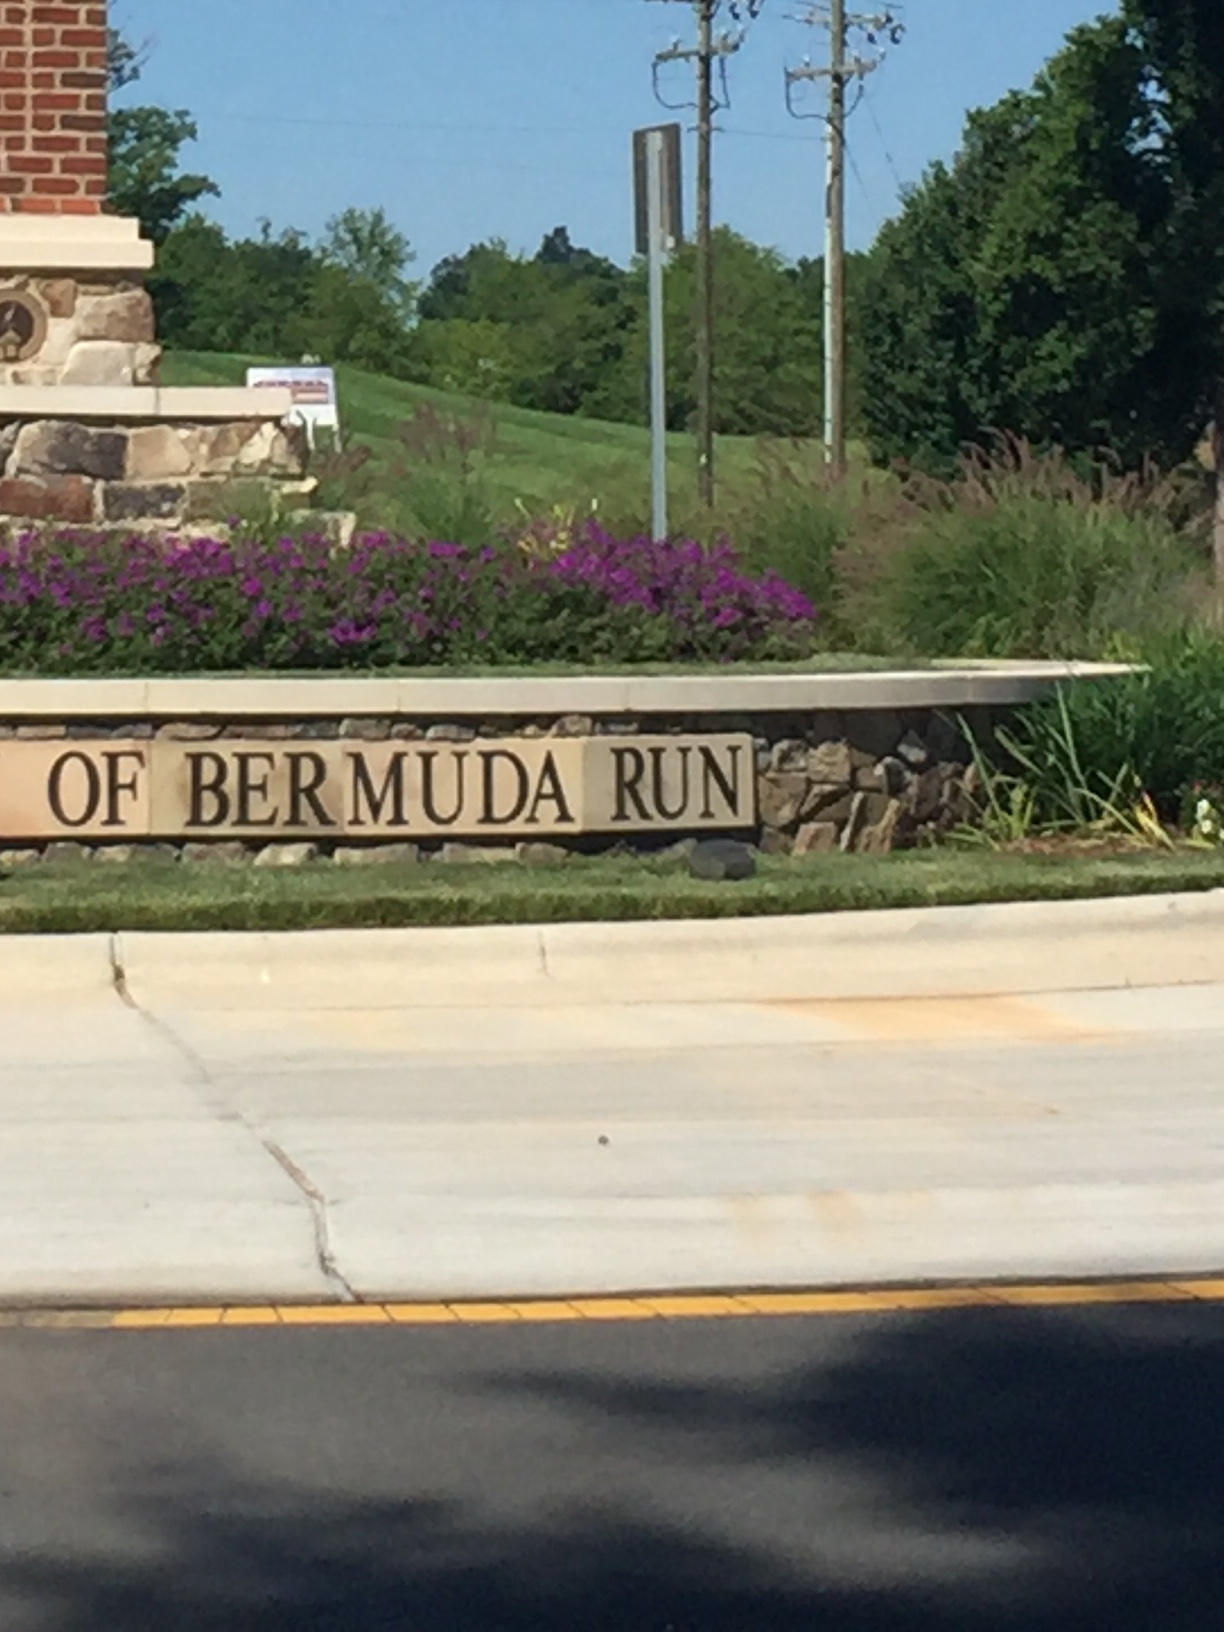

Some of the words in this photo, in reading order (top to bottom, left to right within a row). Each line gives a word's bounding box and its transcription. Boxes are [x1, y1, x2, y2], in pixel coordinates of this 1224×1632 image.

[47, 750, 146, 827] OF
[184, 749, 575, 828] BERMUDA
[609, 744, 743, 822] RUN
